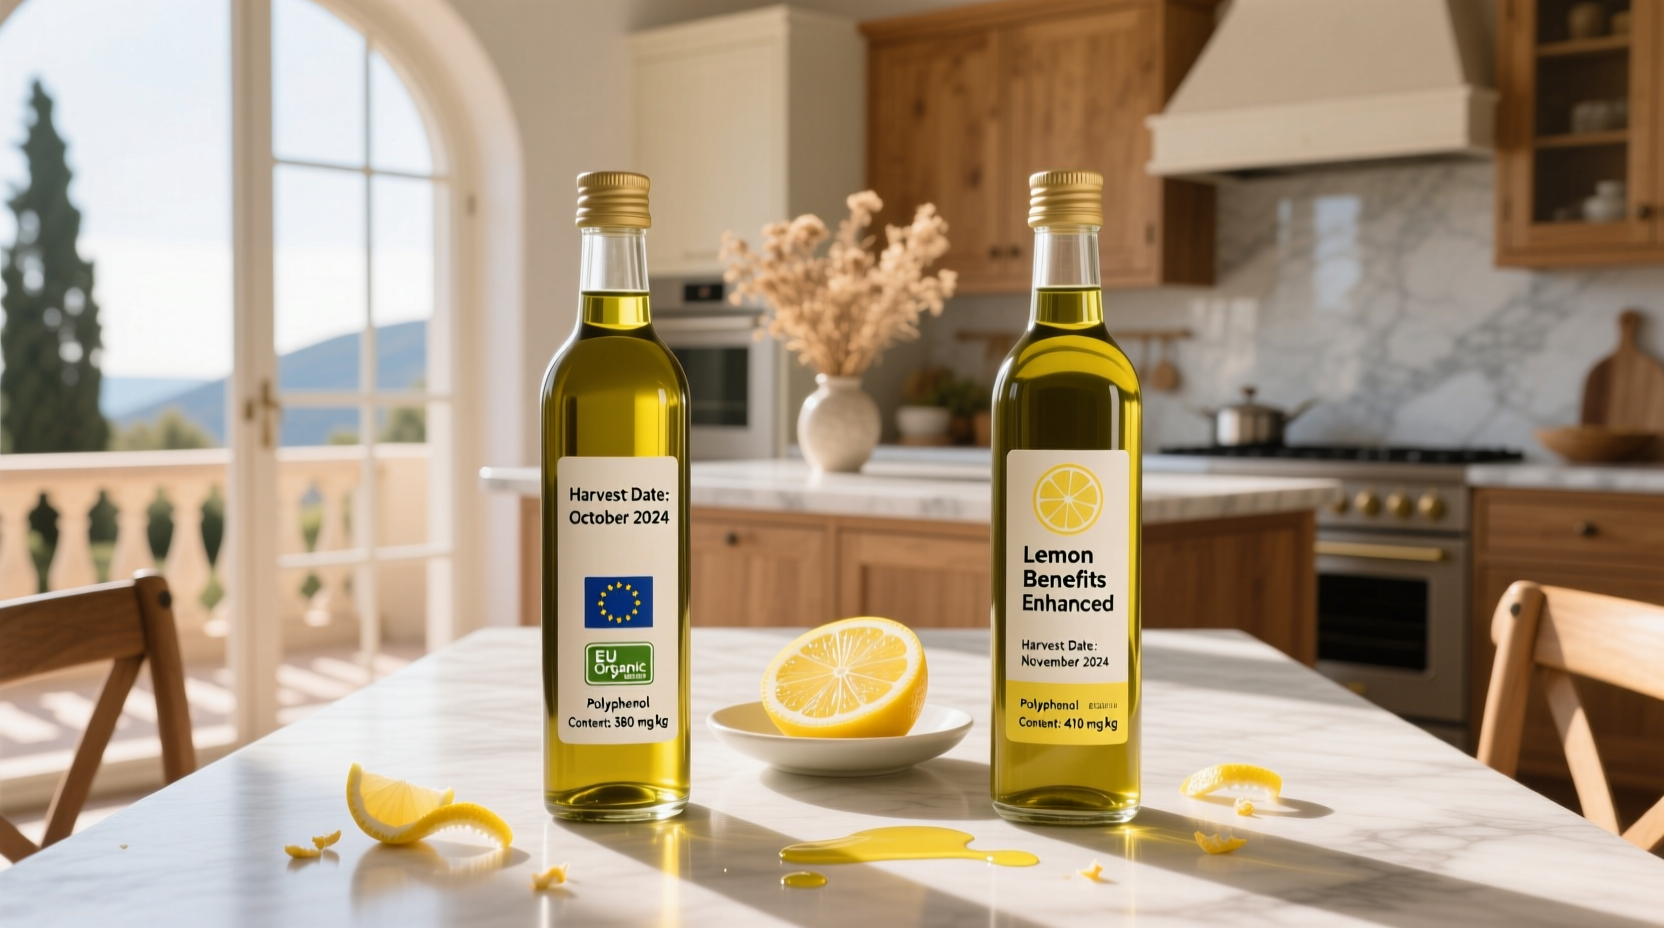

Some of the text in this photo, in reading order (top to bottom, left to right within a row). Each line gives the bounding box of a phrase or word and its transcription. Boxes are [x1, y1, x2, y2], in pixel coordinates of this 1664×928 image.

[569, 487, 670, 502] Harvest Date:
[569, 509, 670, 525] October 2024
[1023, 545, 1094, 564] Lemon
[1023, 569, 1107, 588] Benefits
[1022, 593, 1114, 612] Enhanced
[1021, 639, 1098, 651] Harvest Date:
[595, 649, 617, 663] EU
[1021, 654, 1109, 667] November 2024
[594, 661, 647, 679] Organic
[587, 696, 650, 713] Polyphenol
[1063, 717, 1084, 729] 410
